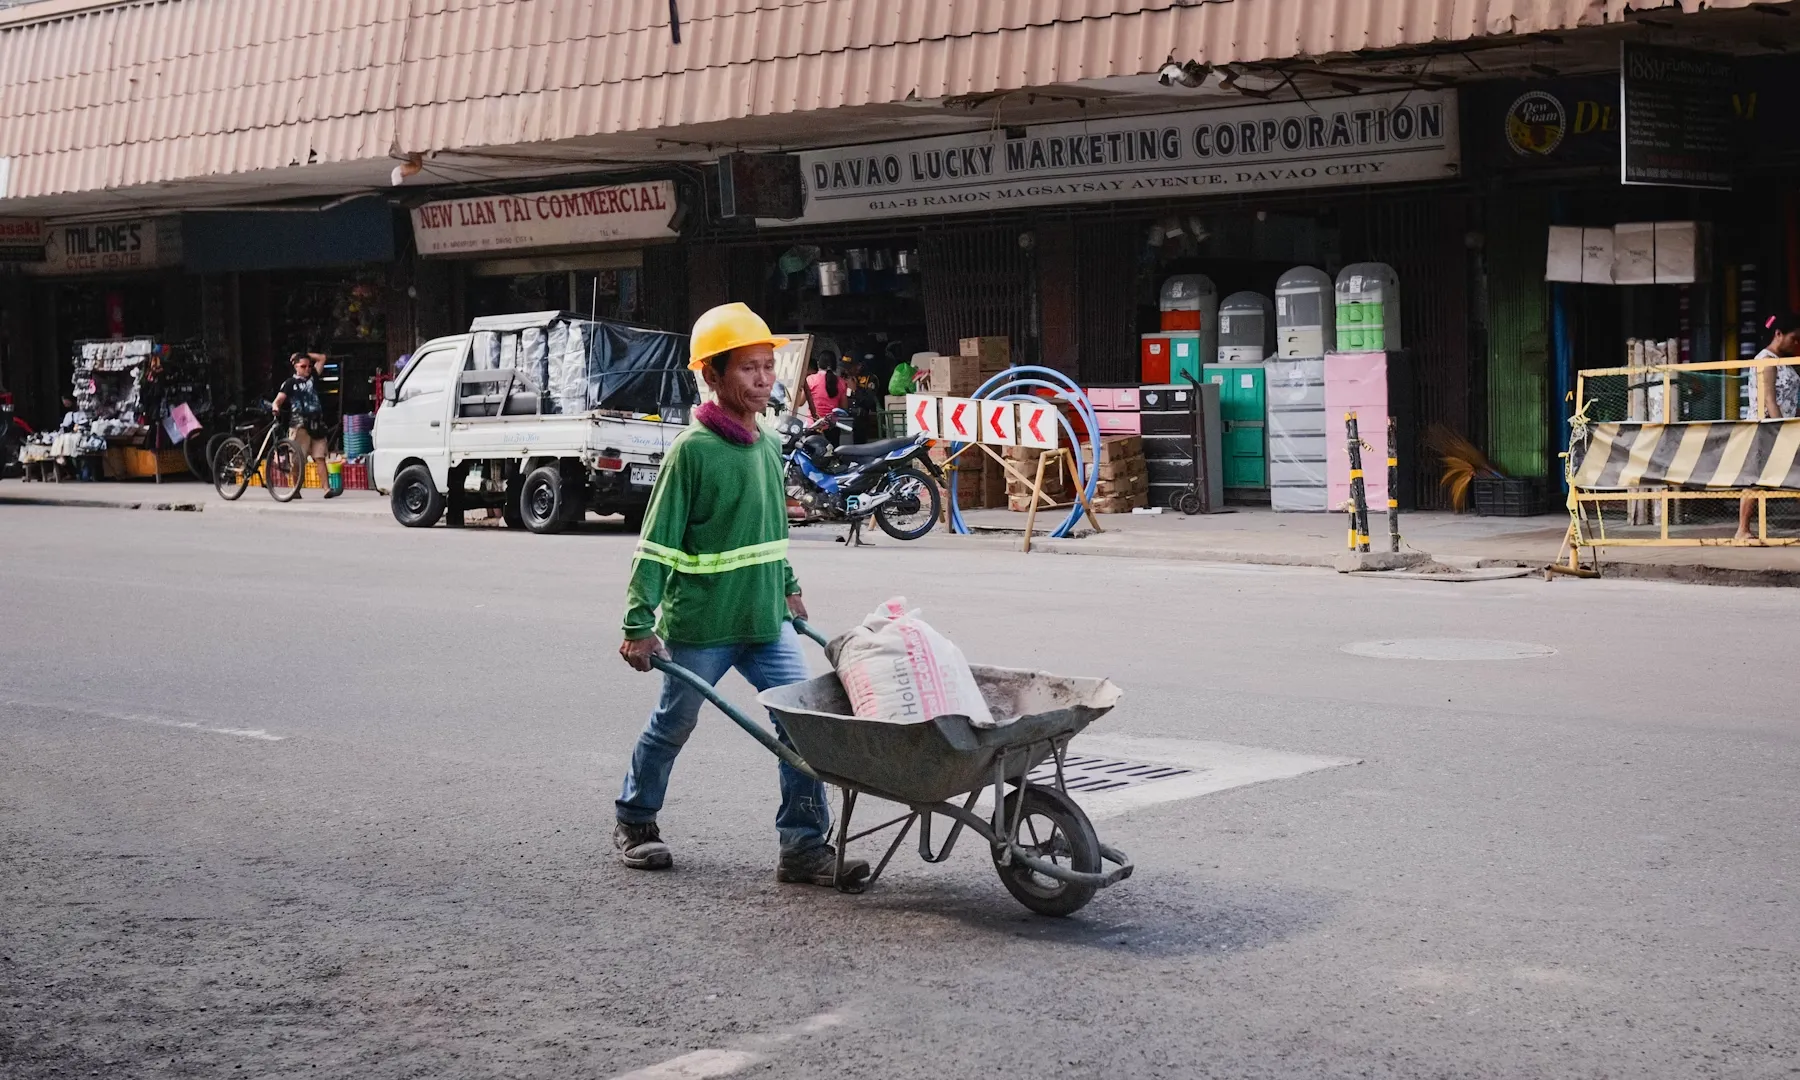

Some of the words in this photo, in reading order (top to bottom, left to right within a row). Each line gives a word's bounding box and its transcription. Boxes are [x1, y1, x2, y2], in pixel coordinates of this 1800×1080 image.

[1522, 102, 1550, 113] Dew
[1524, 112, 1557, 123] Foam
[814, 155, 901, 190] DAVAO
[910, 145, 994, 181] LUCKY
[1005, 127, 1181, 172] MARKETING
[1194, 104, 1442, 157] CORPORATION
[869, 198, 917, 210] 61A-B
[923, 191, 990, 206] RAMON
[998, 180, 1125, 198] MAGSAYSAY
[1132, 174, 1228, 189] AVENUE,
[1236, 167, 1317, 183] DAVAO
[1324, 161, 1385, 176] CITY
[420, 203, 453, 229] NEW
[460, 200, 497, 226] LIAN
[498, 198, 531, 223] TAI
[536, 185, 667, 220] COMMERCIAL
[65, 224, 142, 255] MILANE'S
[66, 255, 97, 270] CYCLE
[102, 252, 142, 269] CENTER
[632, 471, 645, 481] MCW
[648, 472, 657, 482] 35
[893, 657, 918, 716] Holcim
